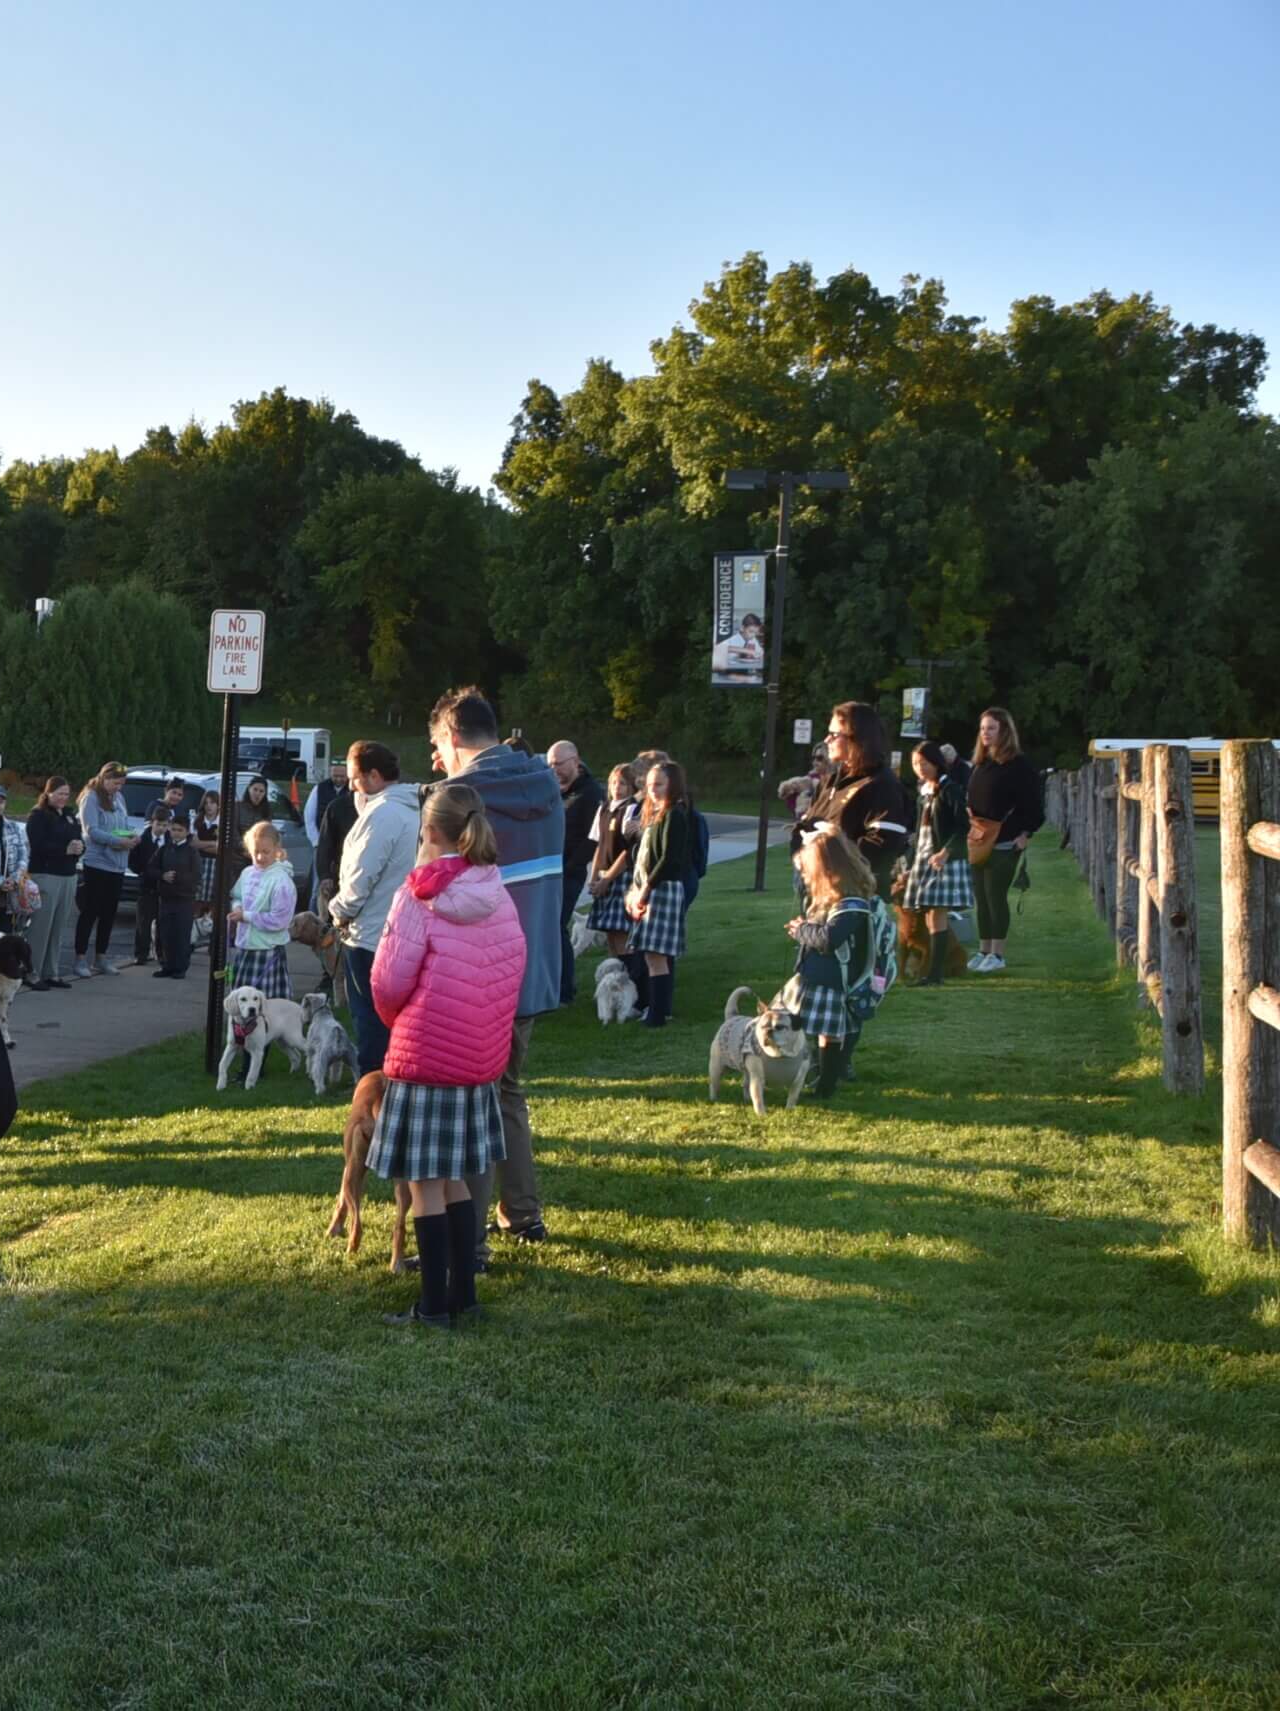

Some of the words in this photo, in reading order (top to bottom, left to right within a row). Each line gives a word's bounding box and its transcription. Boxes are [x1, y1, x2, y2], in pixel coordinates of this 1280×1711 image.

[720, 559, 732, 636] CONFIDENCE
[228, 618, 247, 633] NO
[215, 635, 259, 651] PARKING
[225, 652, 246, 664] FIRE
[222, 665, 247, 676] LANE
